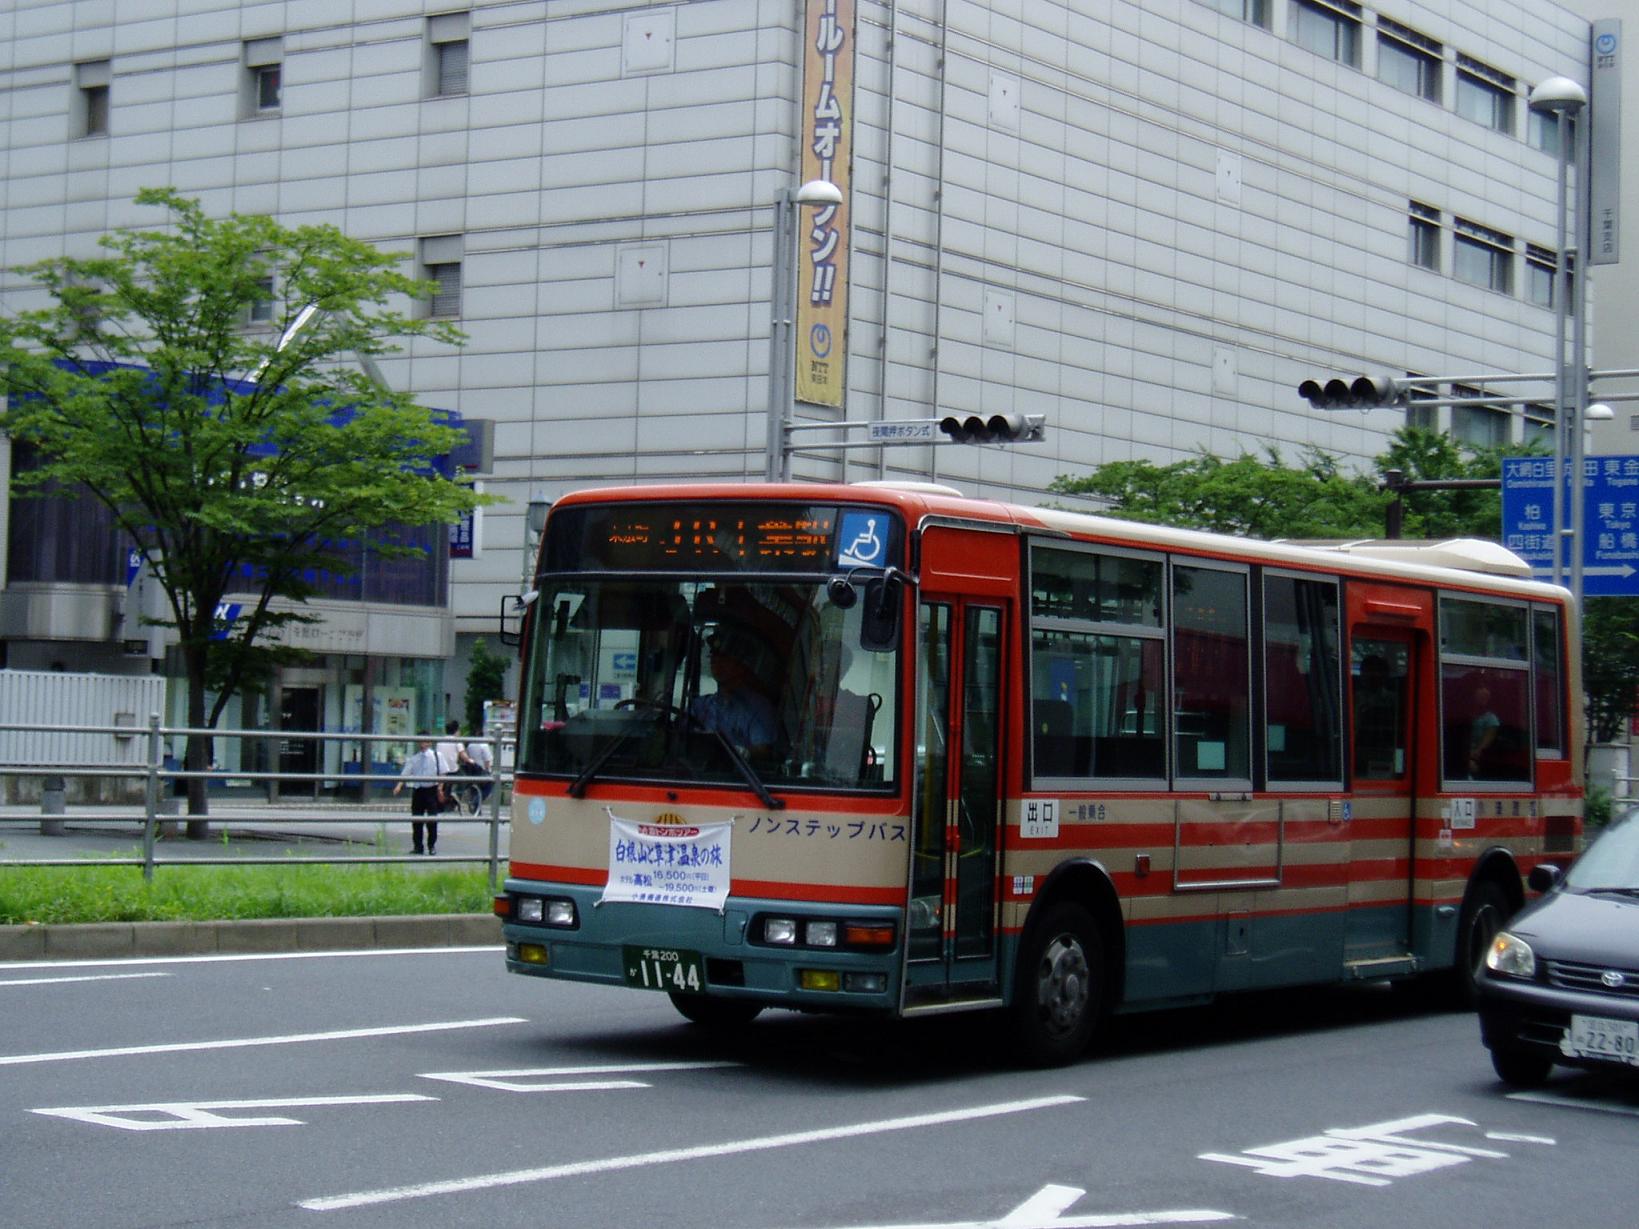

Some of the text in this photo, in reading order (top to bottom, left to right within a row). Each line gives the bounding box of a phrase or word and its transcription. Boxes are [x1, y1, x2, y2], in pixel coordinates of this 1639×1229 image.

[1598, 502, 1637, 518] 東京
[1027, 802, 1053, 822] 出口
[750, 817, 906, 841] ノンステップバス
[640, 959, 700, 991] 11-44
